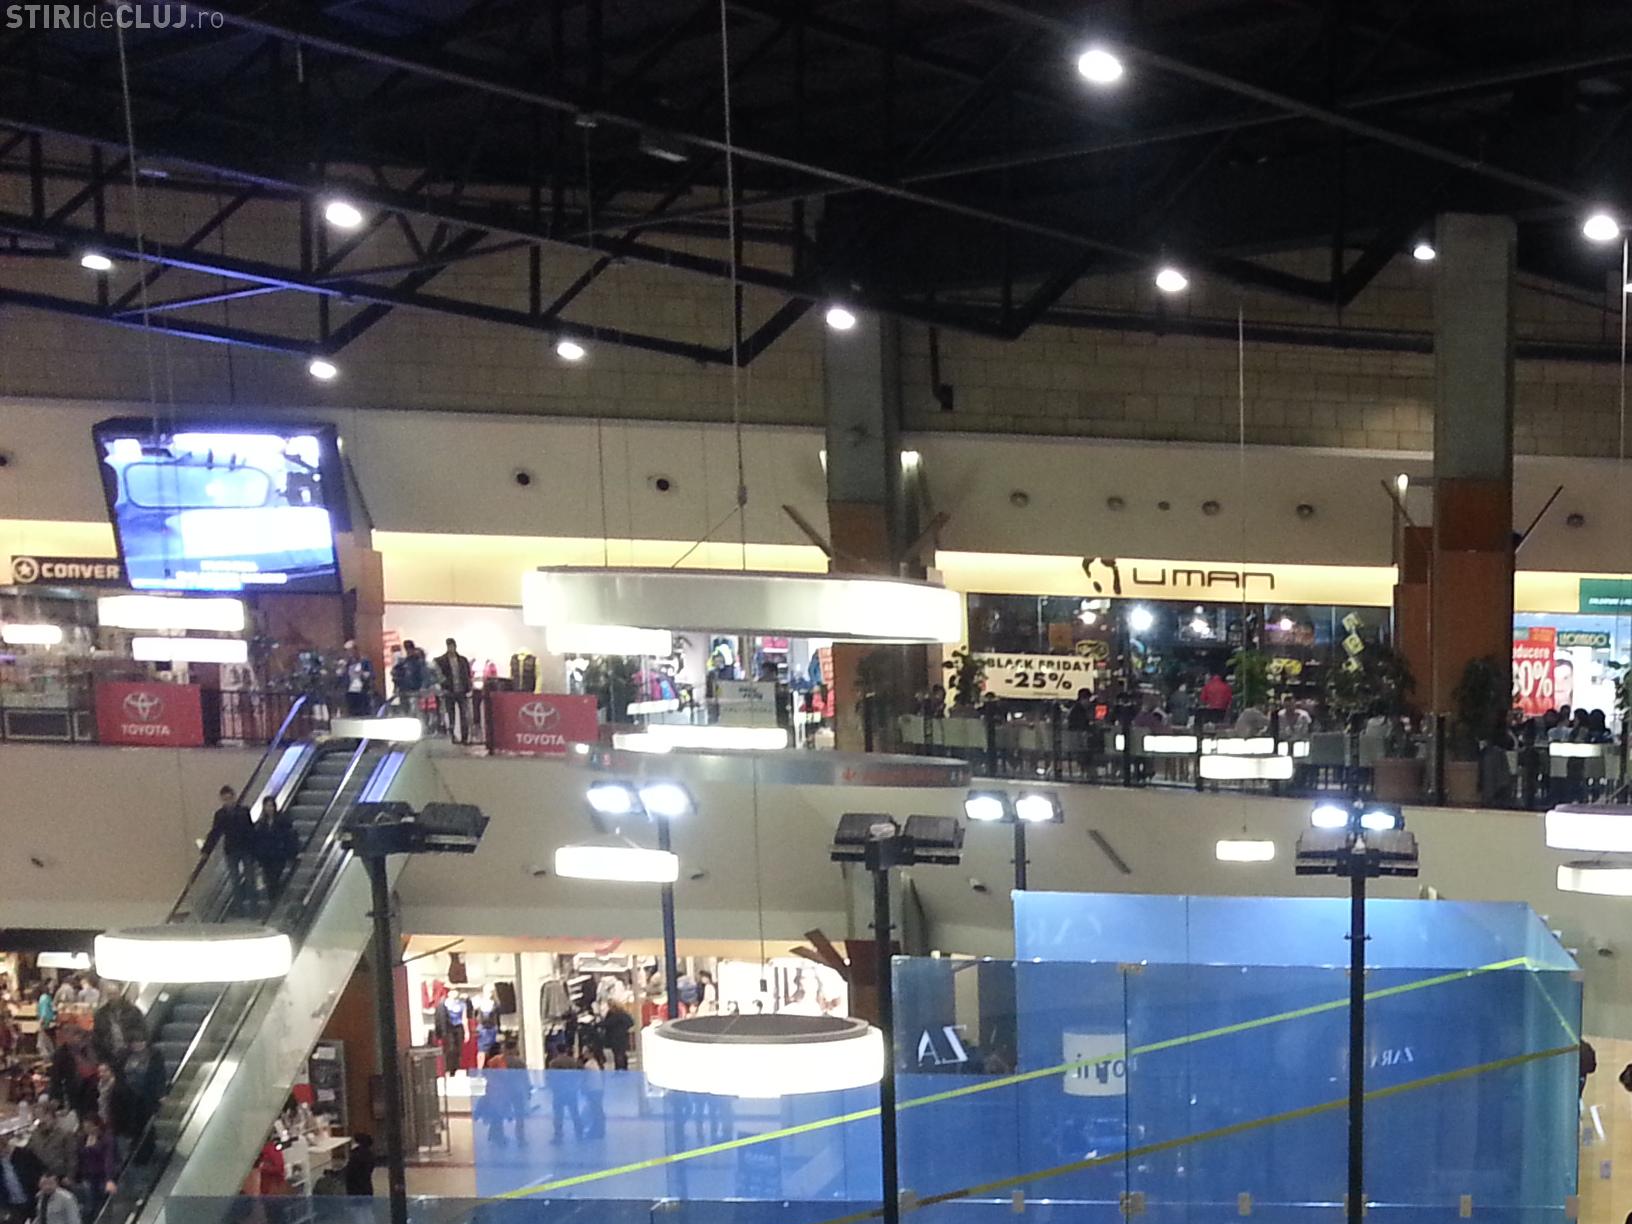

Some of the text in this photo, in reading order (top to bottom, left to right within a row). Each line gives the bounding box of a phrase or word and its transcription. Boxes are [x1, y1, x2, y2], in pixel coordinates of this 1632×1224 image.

[986, 657, 1092, 672] BLACK FRIDAY
[1004, 671, 1073, 690] -25%
[121, 724, 171, 736] TOYOTA
[516, 733, 566, 746] TOYOTA
